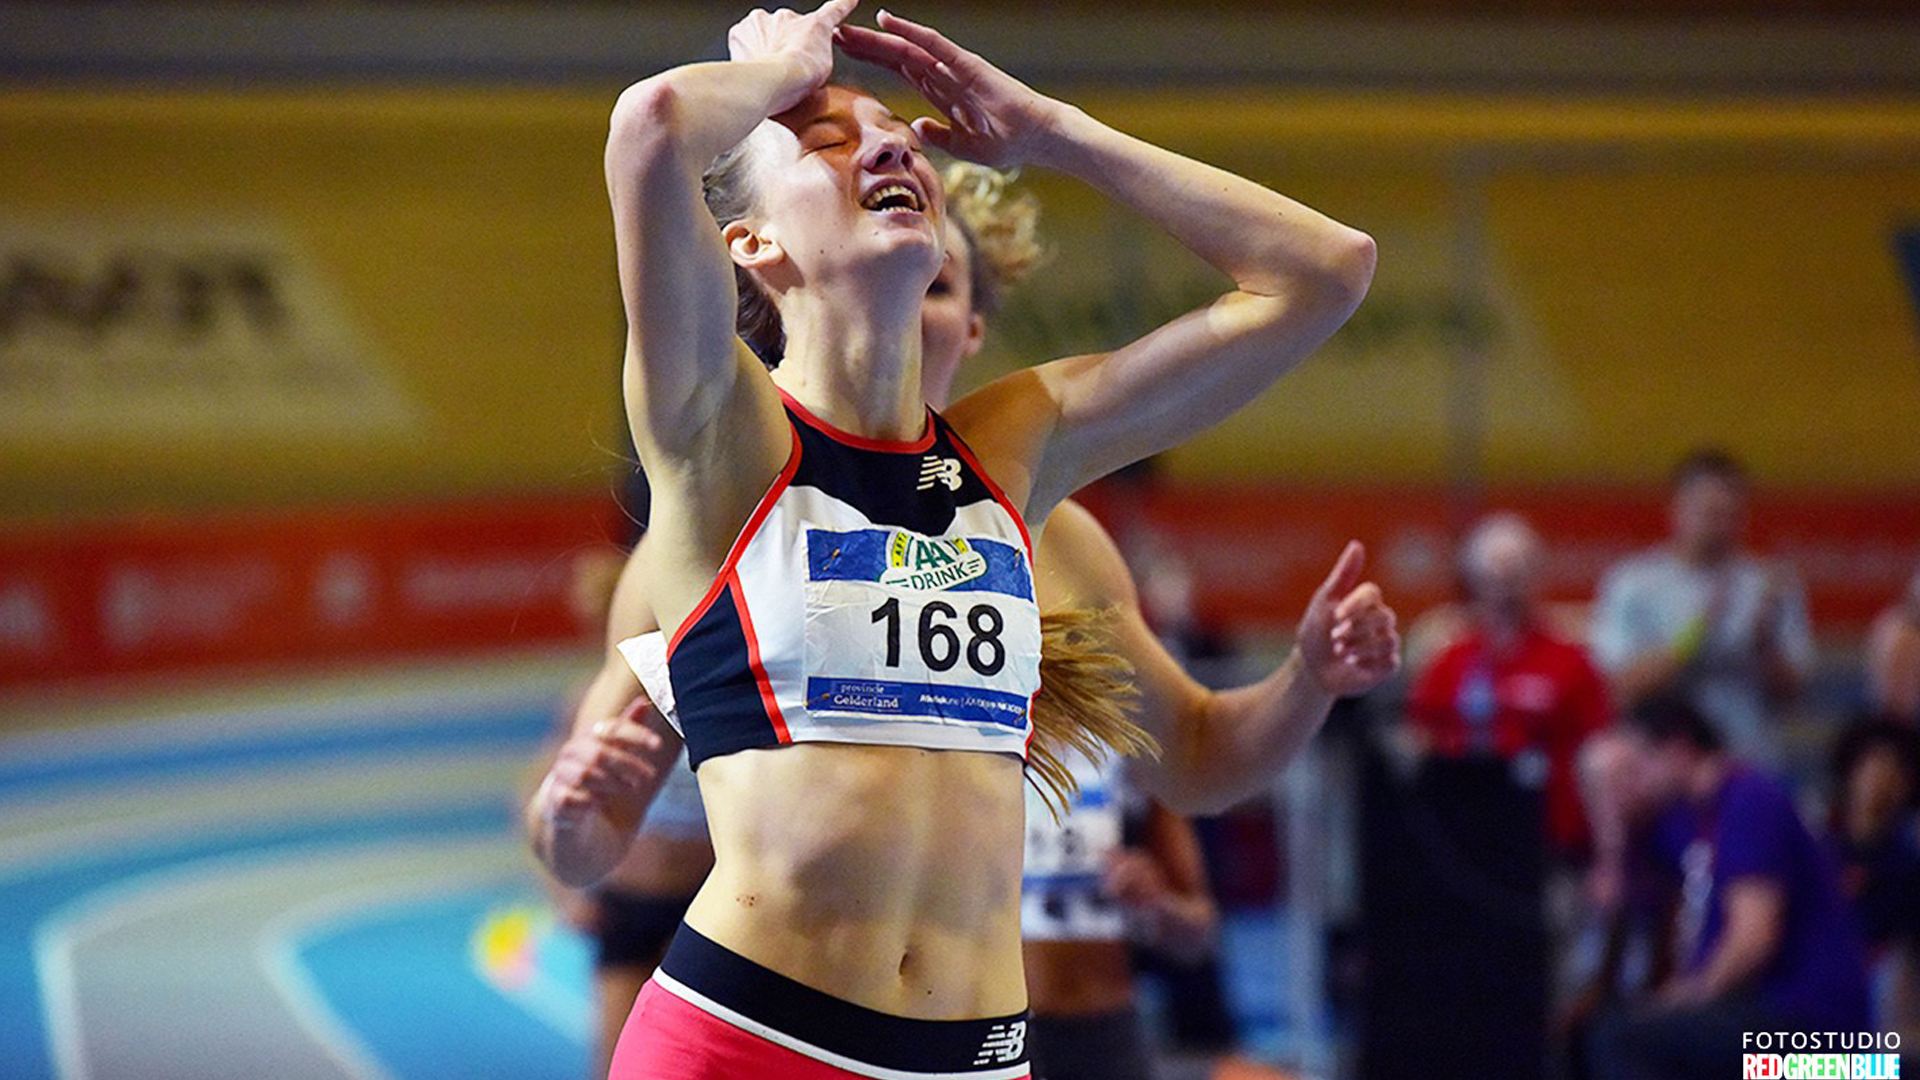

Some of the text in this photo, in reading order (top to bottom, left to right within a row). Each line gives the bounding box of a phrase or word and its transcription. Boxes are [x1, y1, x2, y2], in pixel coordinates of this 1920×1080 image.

[916, 540, 955, 570] AA
[911, 562, 969, 590] DRINK
[871, 597, 1005, 677] 168
[833, 694, 899, 708] Gelderland
